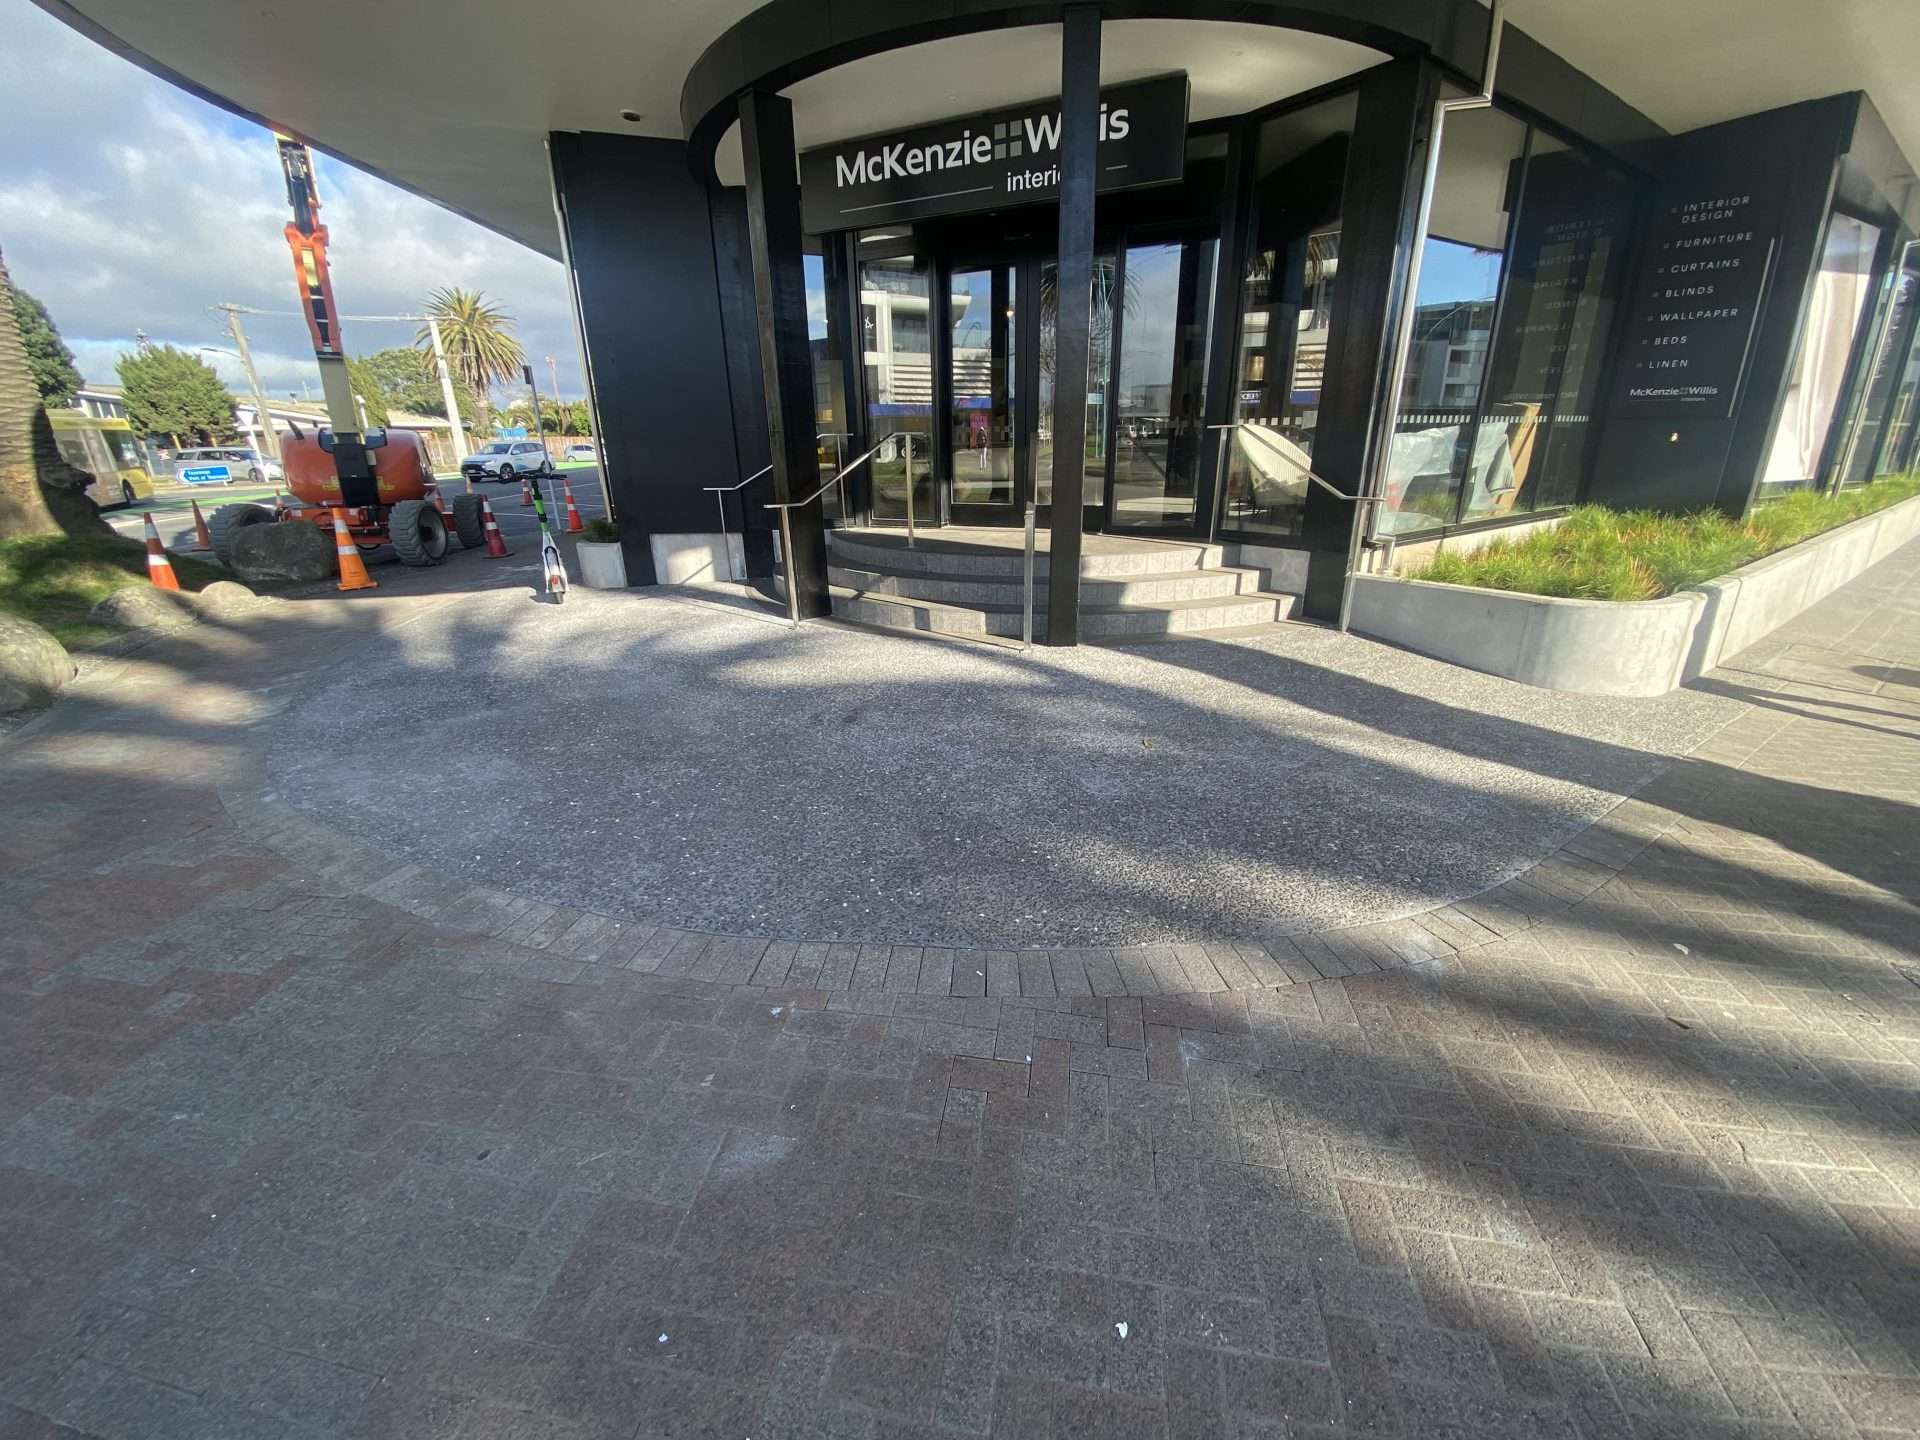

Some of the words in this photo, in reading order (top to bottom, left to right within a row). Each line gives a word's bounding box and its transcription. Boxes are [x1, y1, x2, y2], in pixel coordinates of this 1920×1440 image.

[835, 130, 991, 188] McKenzie
[1024, 103, 1130, 153] Wis
[1007, 164, 1061, 192] interi
[1683, 196, 1750, 213] INTERIOR
[1681, 209, 1734, 224] DESIGN
[1675, 232, 1753, 249] FURNITURE
[1671, 258, 1740, 273] CURTAINS
[1665, 286, 1715, 298] BLINDS
[1660, 308, 1739, 322] WALLPAPER
[1654, 336, 1688, 345] BEDS
[1648, 359, 1689, 369] LINEN
[1629, 387, 1680, 397] McKenzie
[1688, 386, 1719, 395] Willis
